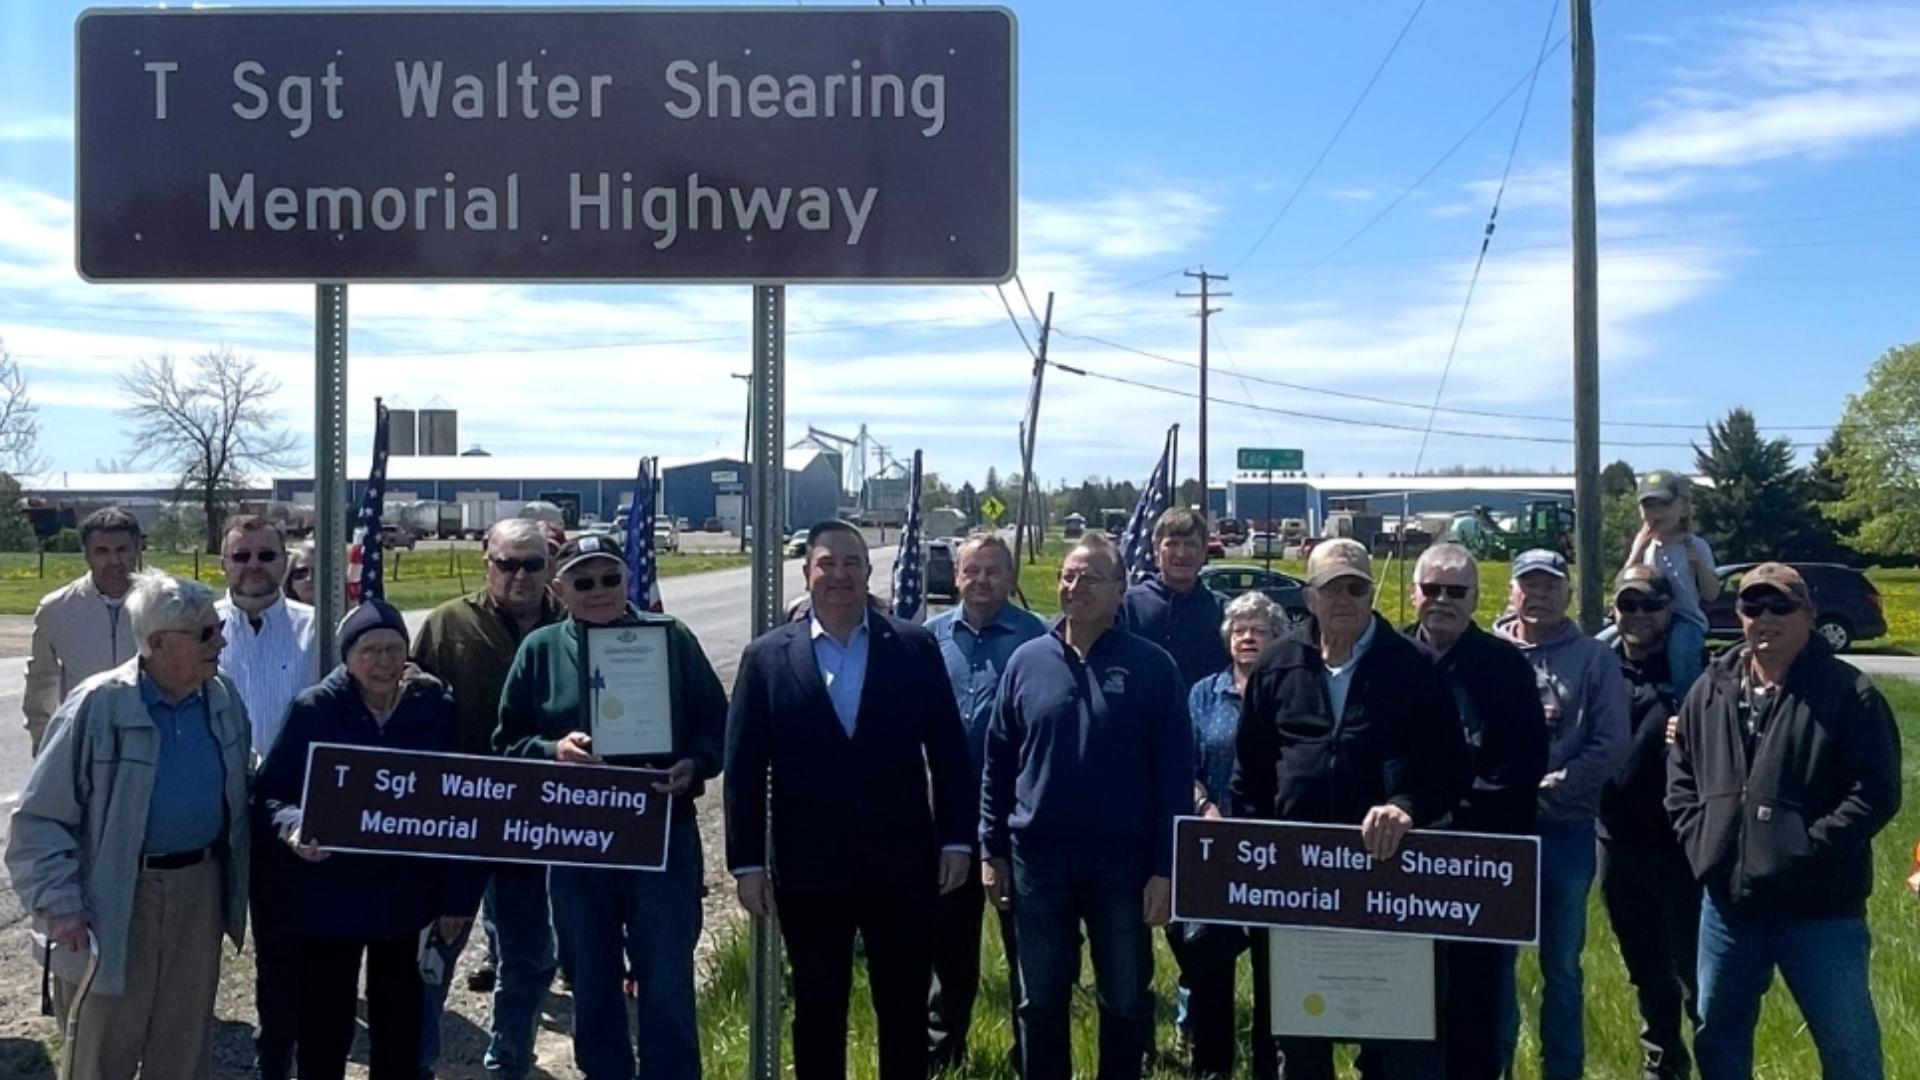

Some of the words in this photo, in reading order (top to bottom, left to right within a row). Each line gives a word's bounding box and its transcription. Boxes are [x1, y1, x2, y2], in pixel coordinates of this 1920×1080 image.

[144, 62, 178, 120] T
[232, 60, 344, 139] Sgt
[395, 60, 613, 119] Walter
[664, 59, 945, 137] Shearing
[209, 171, 518, 231] Memorial
[569, 171, 878, 249] Highway
[335, 765, 350, 788] T
[374, 769, 417, 799] Sgt
[442, 773, 517, 800] Walter
[541, 781, 647, 815] Shearing
[360, 809, 478, 839] Memorial
[503, 819, 614, 853] Highway
[1199, 838, 1214, 860] T
[1237, 840, 1277, 871] Sgt
[1401, 850, 1513, 887] Shearing
[1228, 882, 1340, 911] Memorial
[1367, 890, 1481, 926] Highway
